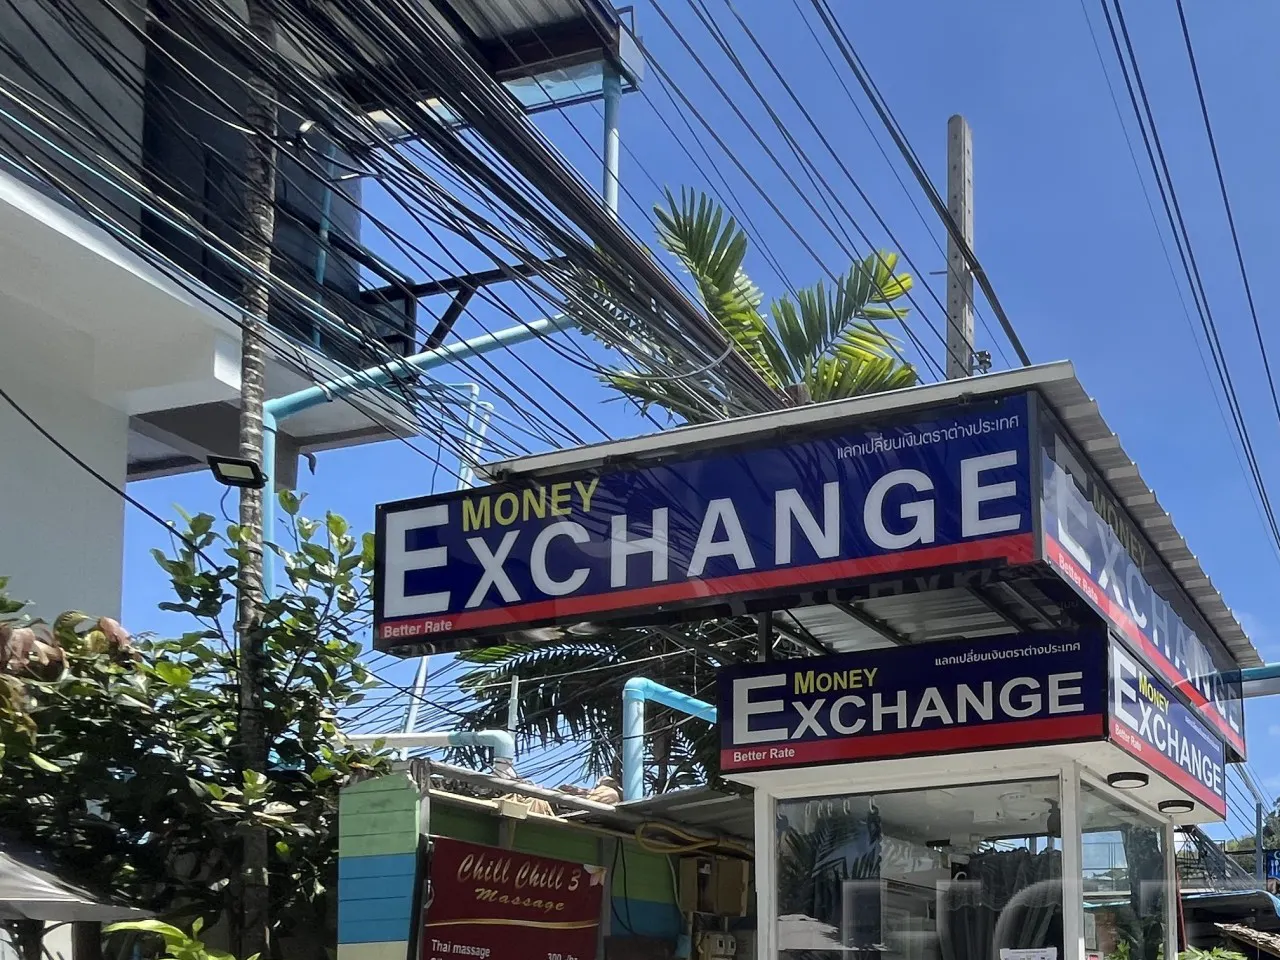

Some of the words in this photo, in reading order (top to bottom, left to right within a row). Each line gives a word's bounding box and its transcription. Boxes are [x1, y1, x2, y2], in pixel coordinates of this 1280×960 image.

[837, 415, 1019, 459] แลกเปลี่ยนเงินตราต่างประเทศ
[462, 478, 599, 532] MONEY
[384, 450, 1021, 618] EXCHANGE
[1059, 553, 1082, 587] Better
[1083, 578, 1098, 604] Rate
[384, 624, 421, 638] Better
[424, 621, 452, 633] Rate
[935, 642, 1080, 666] แลกเปลี่ยนเงินตราต่างประเทศ
[794, 667, 878, 695] MONEY
[1138, 671, 1169, 715] MONEY
[733, 671, 1084, 745] EXCHANGE
[1113, 646, 1222, 796] EXCHANGE
[733, 750, 766, 762] Better
[770, 748, 795, 759] Rate
[457, 852, 512, 884] Chill
[514, 861, 565, 891] Chill
[567, 869, 582, 892] 3
[474, 887, 565, 914] Massage
[431, 939, 451, 953] Thai
[452, 943, 491, 960] massage
